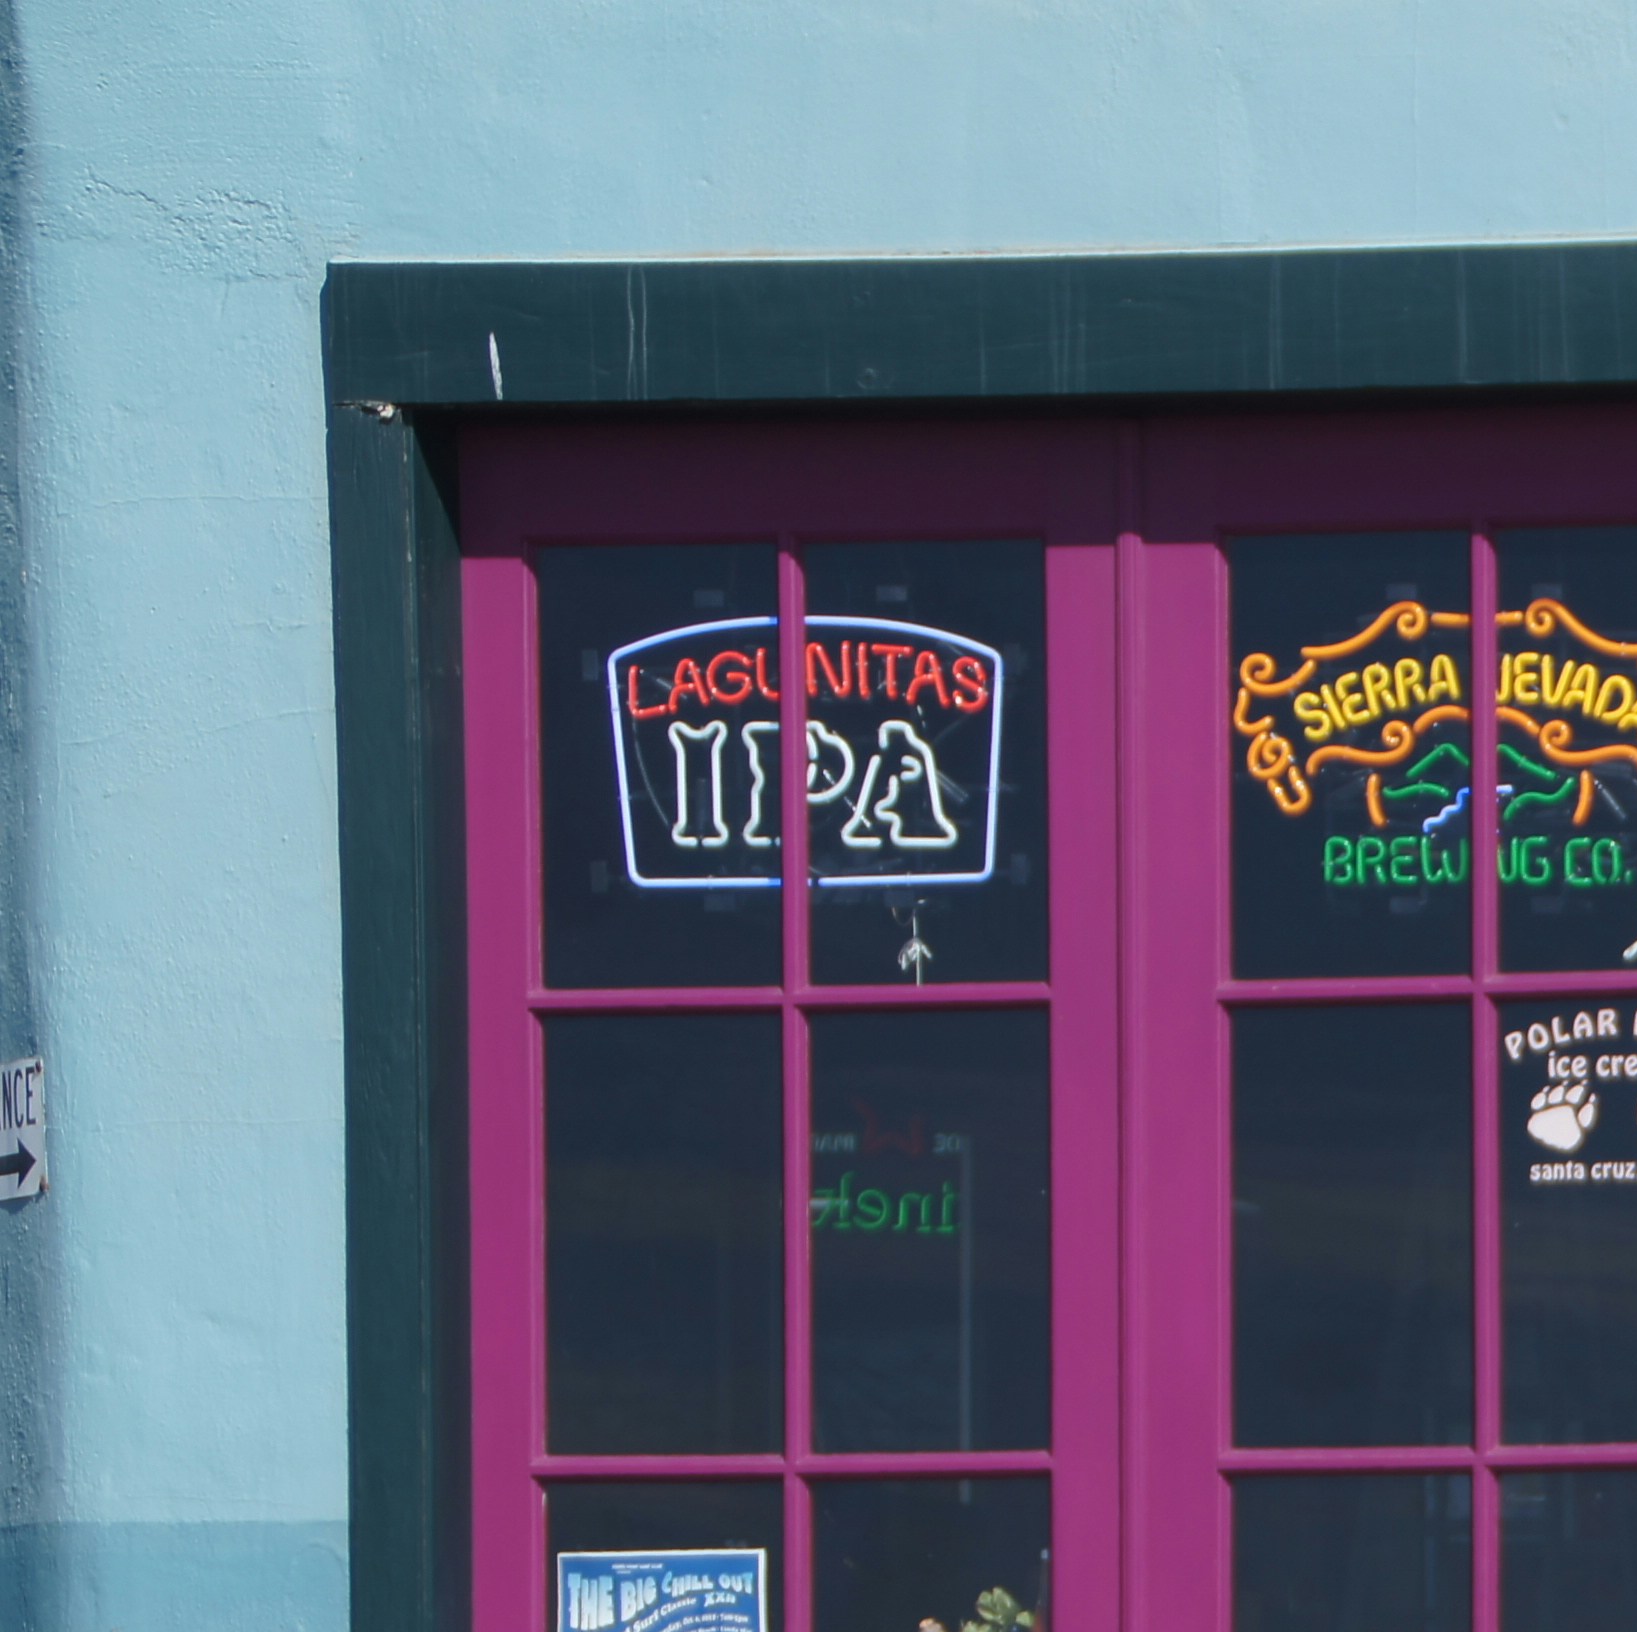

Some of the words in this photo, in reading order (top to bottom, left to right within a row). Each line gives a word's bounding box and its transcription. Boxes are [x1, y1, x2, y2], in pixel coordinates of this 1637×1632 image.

[1294, 653, 1461, 742] SIERRA
[668, 720, 957, 848] IPA
[1323, 835, 1553, 885] BREWNG
[1563, 836, 1634, 886] CO.
[1504, 1008, 1618, 1060] POLAR
[1548, 1051, 1587, 1078] ice
[0, 1066, 36, 1130] NCE
[1529, 1161, 1585, 1181] santa
[568, 1572, 615, 1631] THE
[620, 1576, 657, 1622] BIG
[661, 1571, 714, 1597] CHILL
[718, 1572, 753, 1594] OUT
